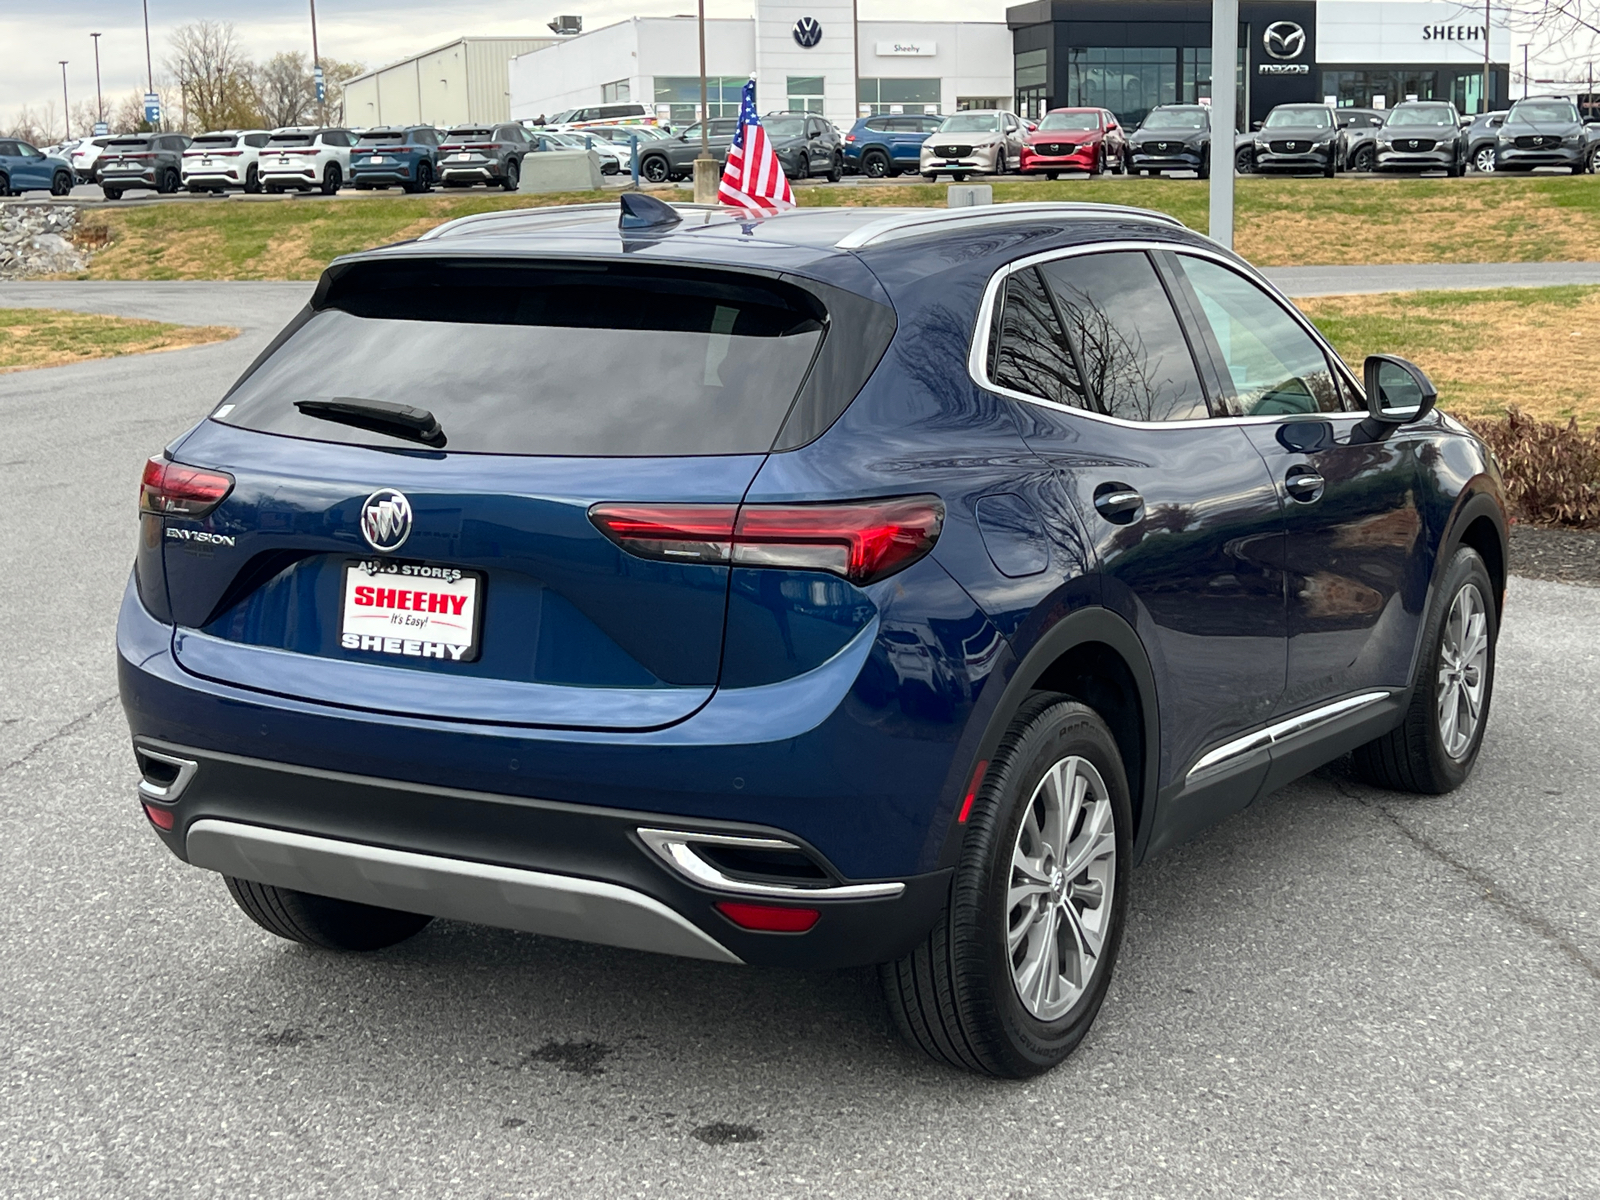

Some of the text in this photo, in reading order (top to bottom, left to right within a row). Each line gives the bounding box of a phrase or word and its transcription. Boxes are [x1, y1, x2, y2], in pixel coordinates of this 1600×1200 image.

[1423, 25, 1490, 41] SHEEHY
[894, 43, 920, 53] Sheehy
[166, 527, 236, 546] ENVISION
[402, 565, 461, 580] STORES
[354, 585, 468, 616] SHEEHY
[390, 613, 429, 629] It's Easy!
[341, 633, 468, 660] SHEEHY
